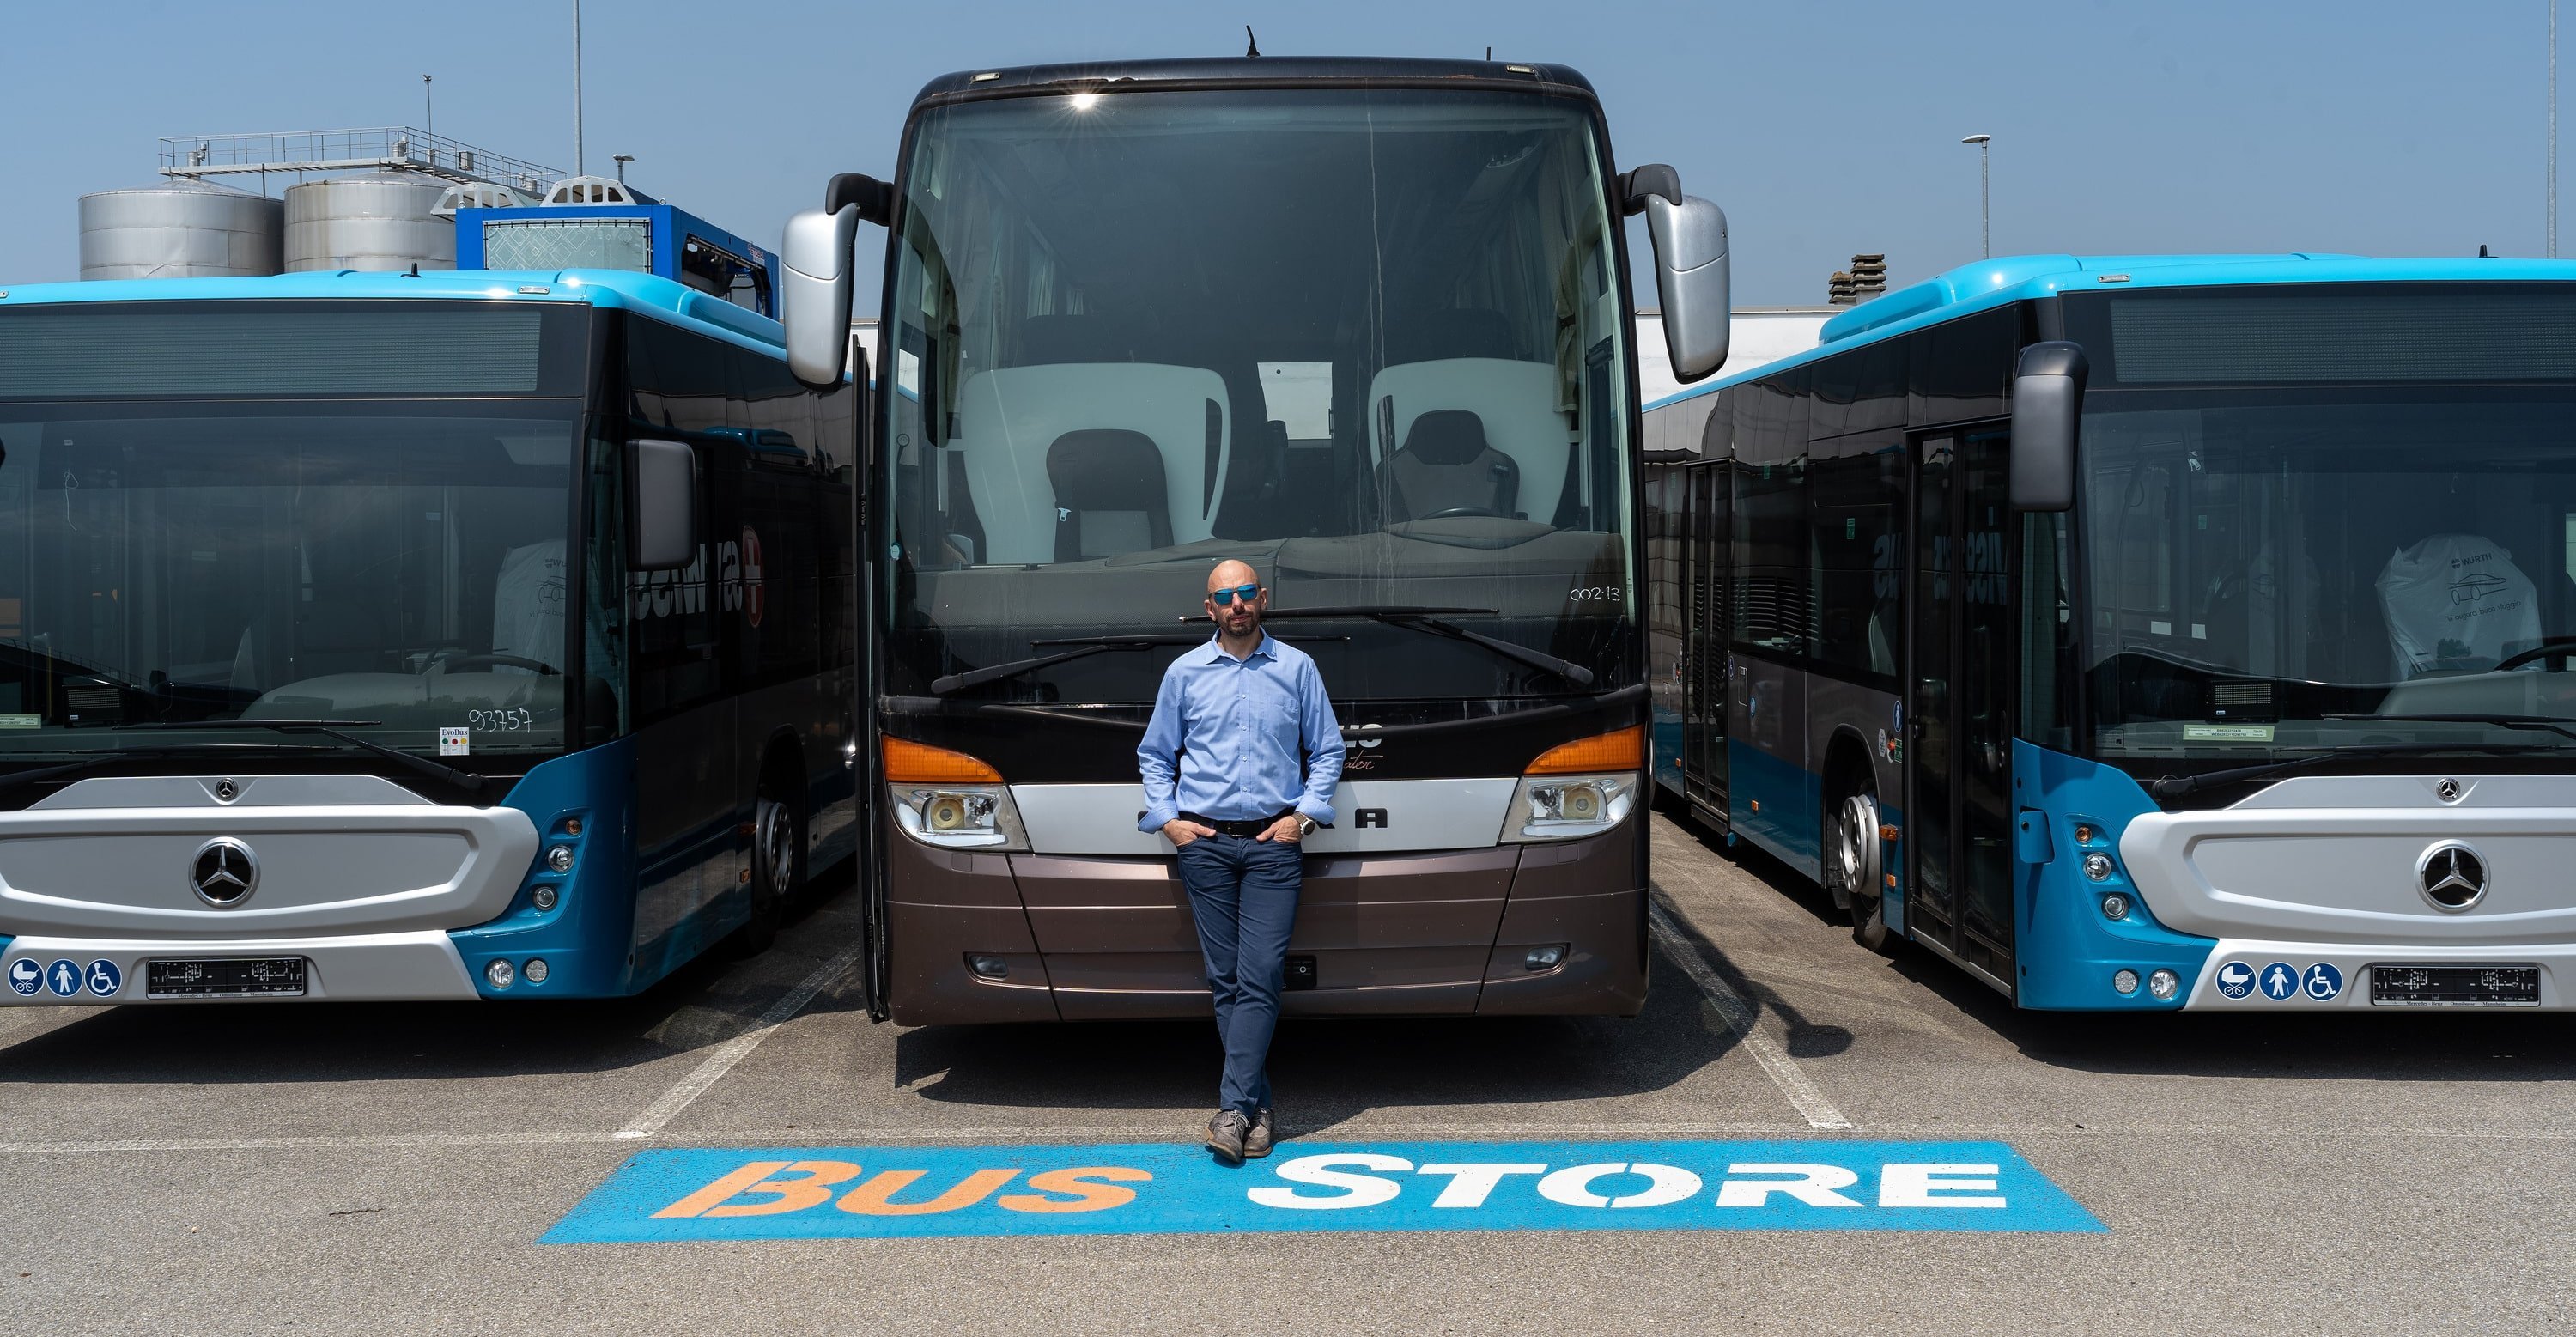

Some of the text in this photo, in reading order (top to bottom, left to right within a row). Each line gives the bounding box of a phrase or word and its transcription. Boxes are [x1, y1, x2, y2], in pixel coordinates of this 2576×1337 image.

[468, 708, 532, 732] 93757
[647, 1153, 2008, 1218] BUS STORE
